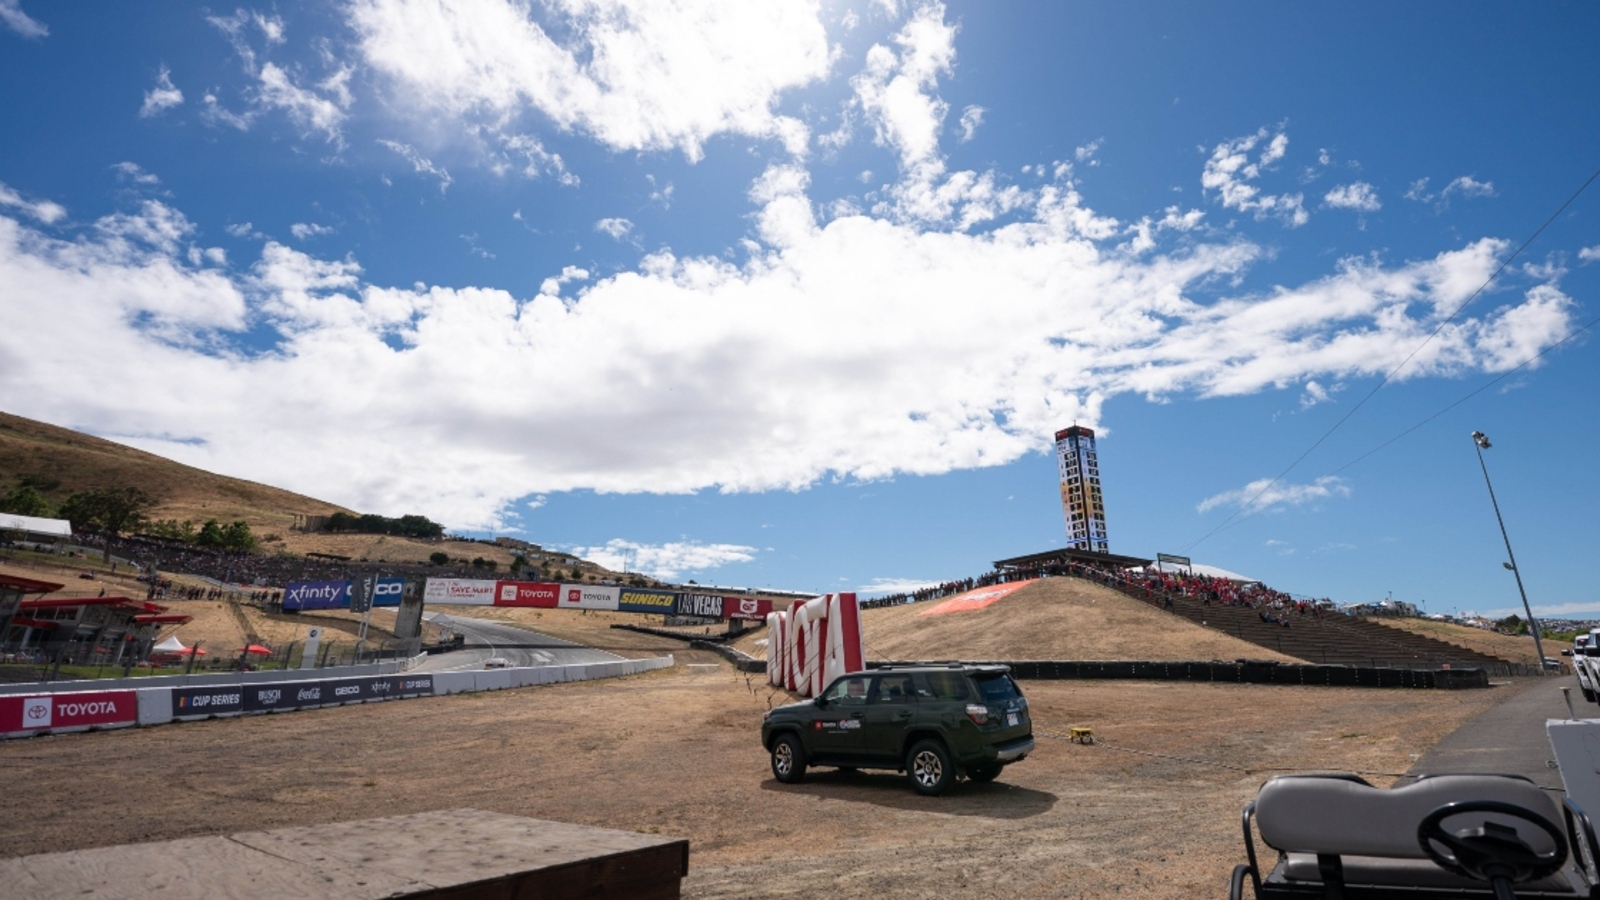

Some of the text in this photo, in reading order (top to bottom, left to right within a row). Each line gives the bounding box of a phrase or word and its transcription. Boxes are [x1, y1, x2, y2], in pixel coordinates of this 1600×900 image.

[289, 585, 340, 602] xfinity
[519, 589, 554, 599] TOYOTA
[583, 593, 611, 601] TOYOTA
[620, 592, 675, 606] SUNOCO
[677, 594, 723, 616] LAS VEGAS
[258, 690, 281, 701] BUSCH
[335, 685, 360, 696] GEICO
[192, 694, 240, 707] CUP SERIES
[57, 701, 117, 718] TOYOTA
